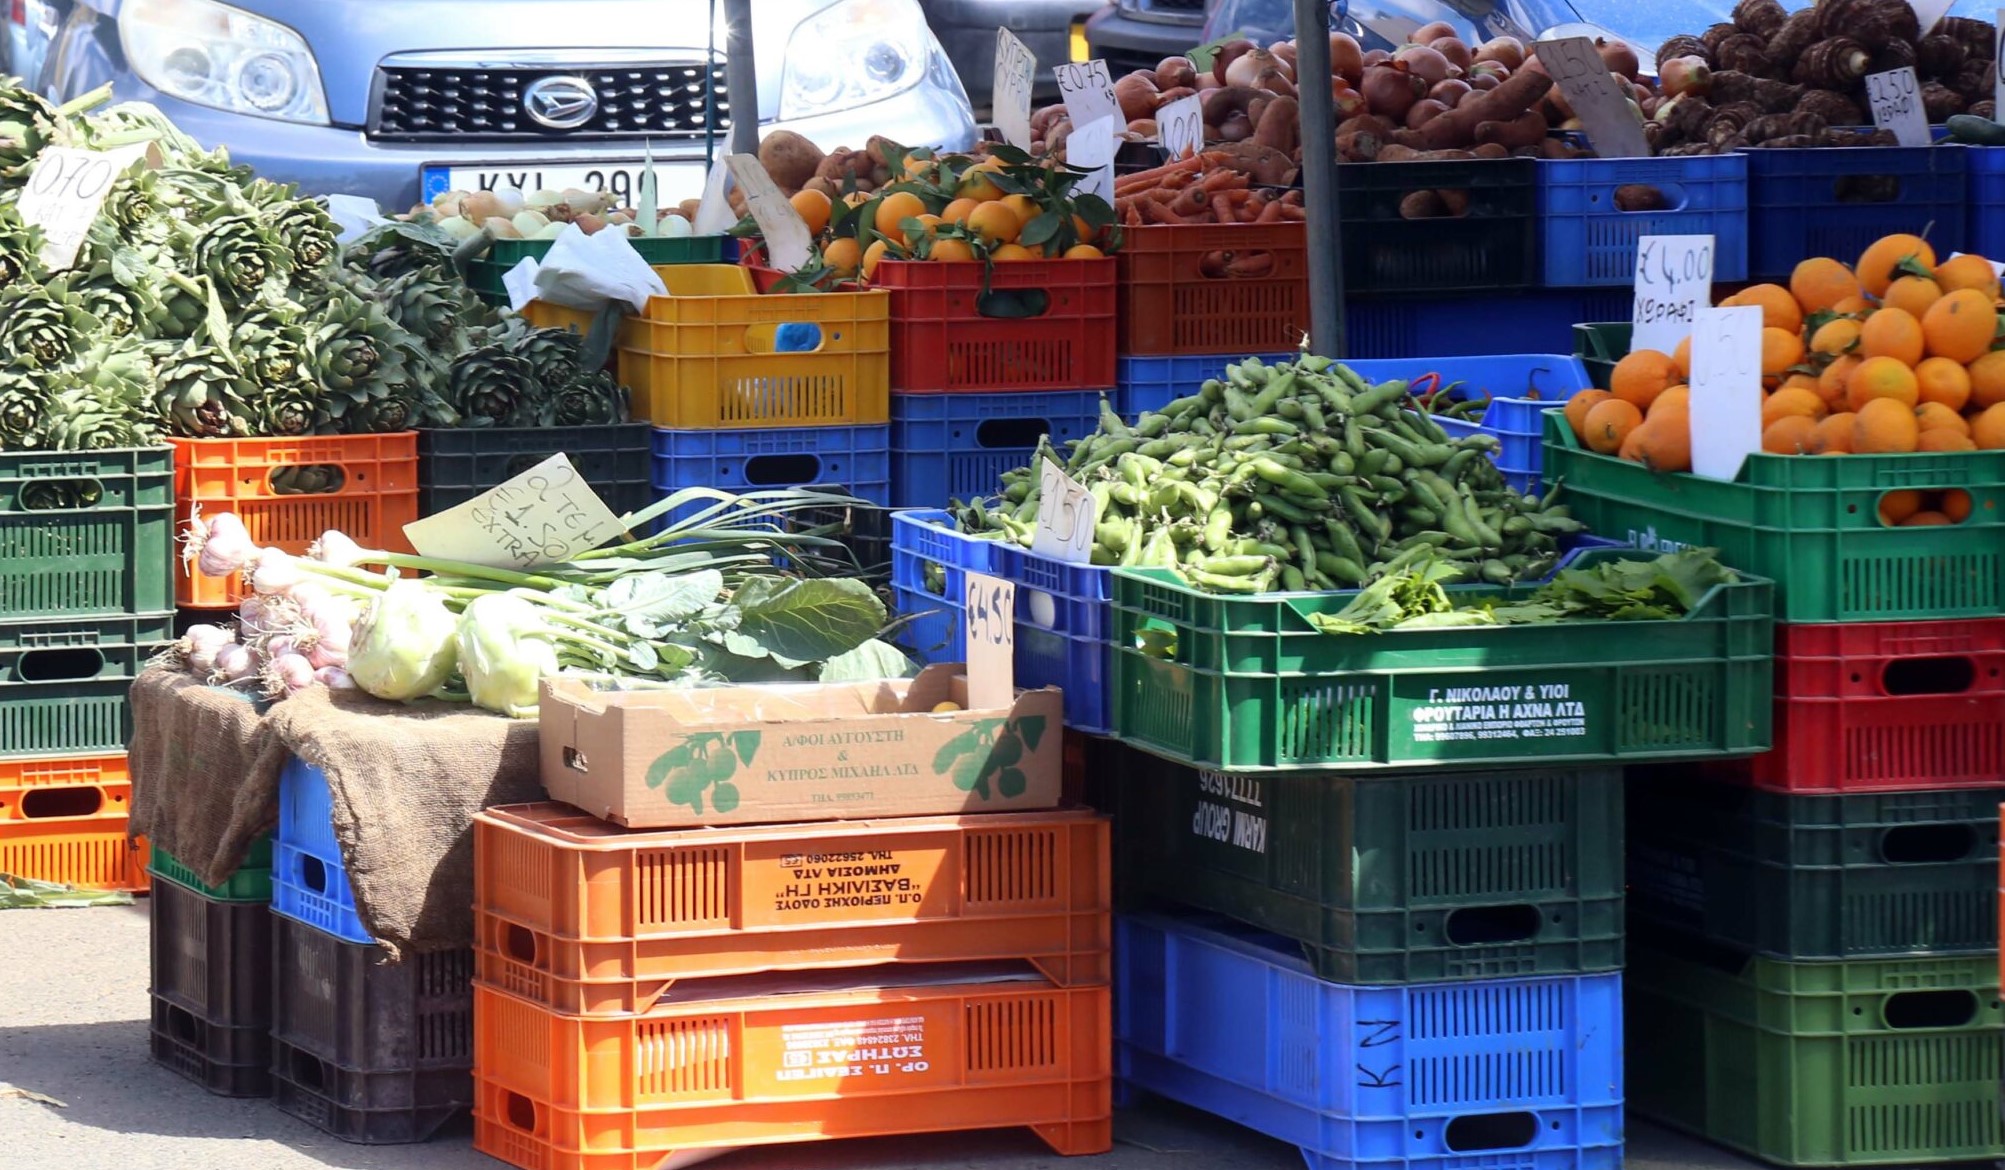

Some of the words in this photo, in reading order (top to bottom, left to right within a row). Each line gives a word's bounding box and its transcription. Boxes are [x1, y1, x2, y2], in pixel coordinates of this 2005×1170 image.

[1057, 61, 1107, 92] €0.75
[1638, 240, 1710, 294] €4.00
[471, 507, 541, 568] EXTRA
[1429, 689, 1443, 703] Γ.
[1446, 686, 1522, 702] ΝΙΚΟΛΑΟΥ
[1524, 685, 1536, 700] &
[1539, 684, 1570, 699] ΥΙΟΙ
[1412, 704, 1496, 723] ΦΡΟΥΤΑΡΙΑ
[1499, 704, 1510, 719] Η
[1512, 702, 1553, 718] ΑΧΝΑ
[1555, 701, 1586, 717] ΛΤΔ
[783, 734, 824, 747] Α/ΦΟΙ
[828, 729, 905, 745] ΑΥΓΟΥΣΤΗ
[837, 750, 849, 761] &
[767, 769, 828, 782] ΚΥΠΡΟΣ
[831, 765, 891, 780] ΜΙΧΑΗΛ
[893, 763, 919, 776] ΛΤΔ
[1192, 800, 1231, 842] GROUP
[793, 868, 823, 880] ΛΤΔ
[827, 864, 901, 877] ΔΗΜΟΣΙΑ
[775, 898, 820, 911] ΟΔΟΥΣ
[824, 893, 891, 908] ΠΕΡΙΟΧΗΣ
[895, 893, 922, 903] Ο.Π.
[816, 1045, 923, 1064] ΣΩΤΗΡΑΣ
[868, 1063, 890, 1075] Π.
[896, 1061, 929, 1072] ΟΡ.
